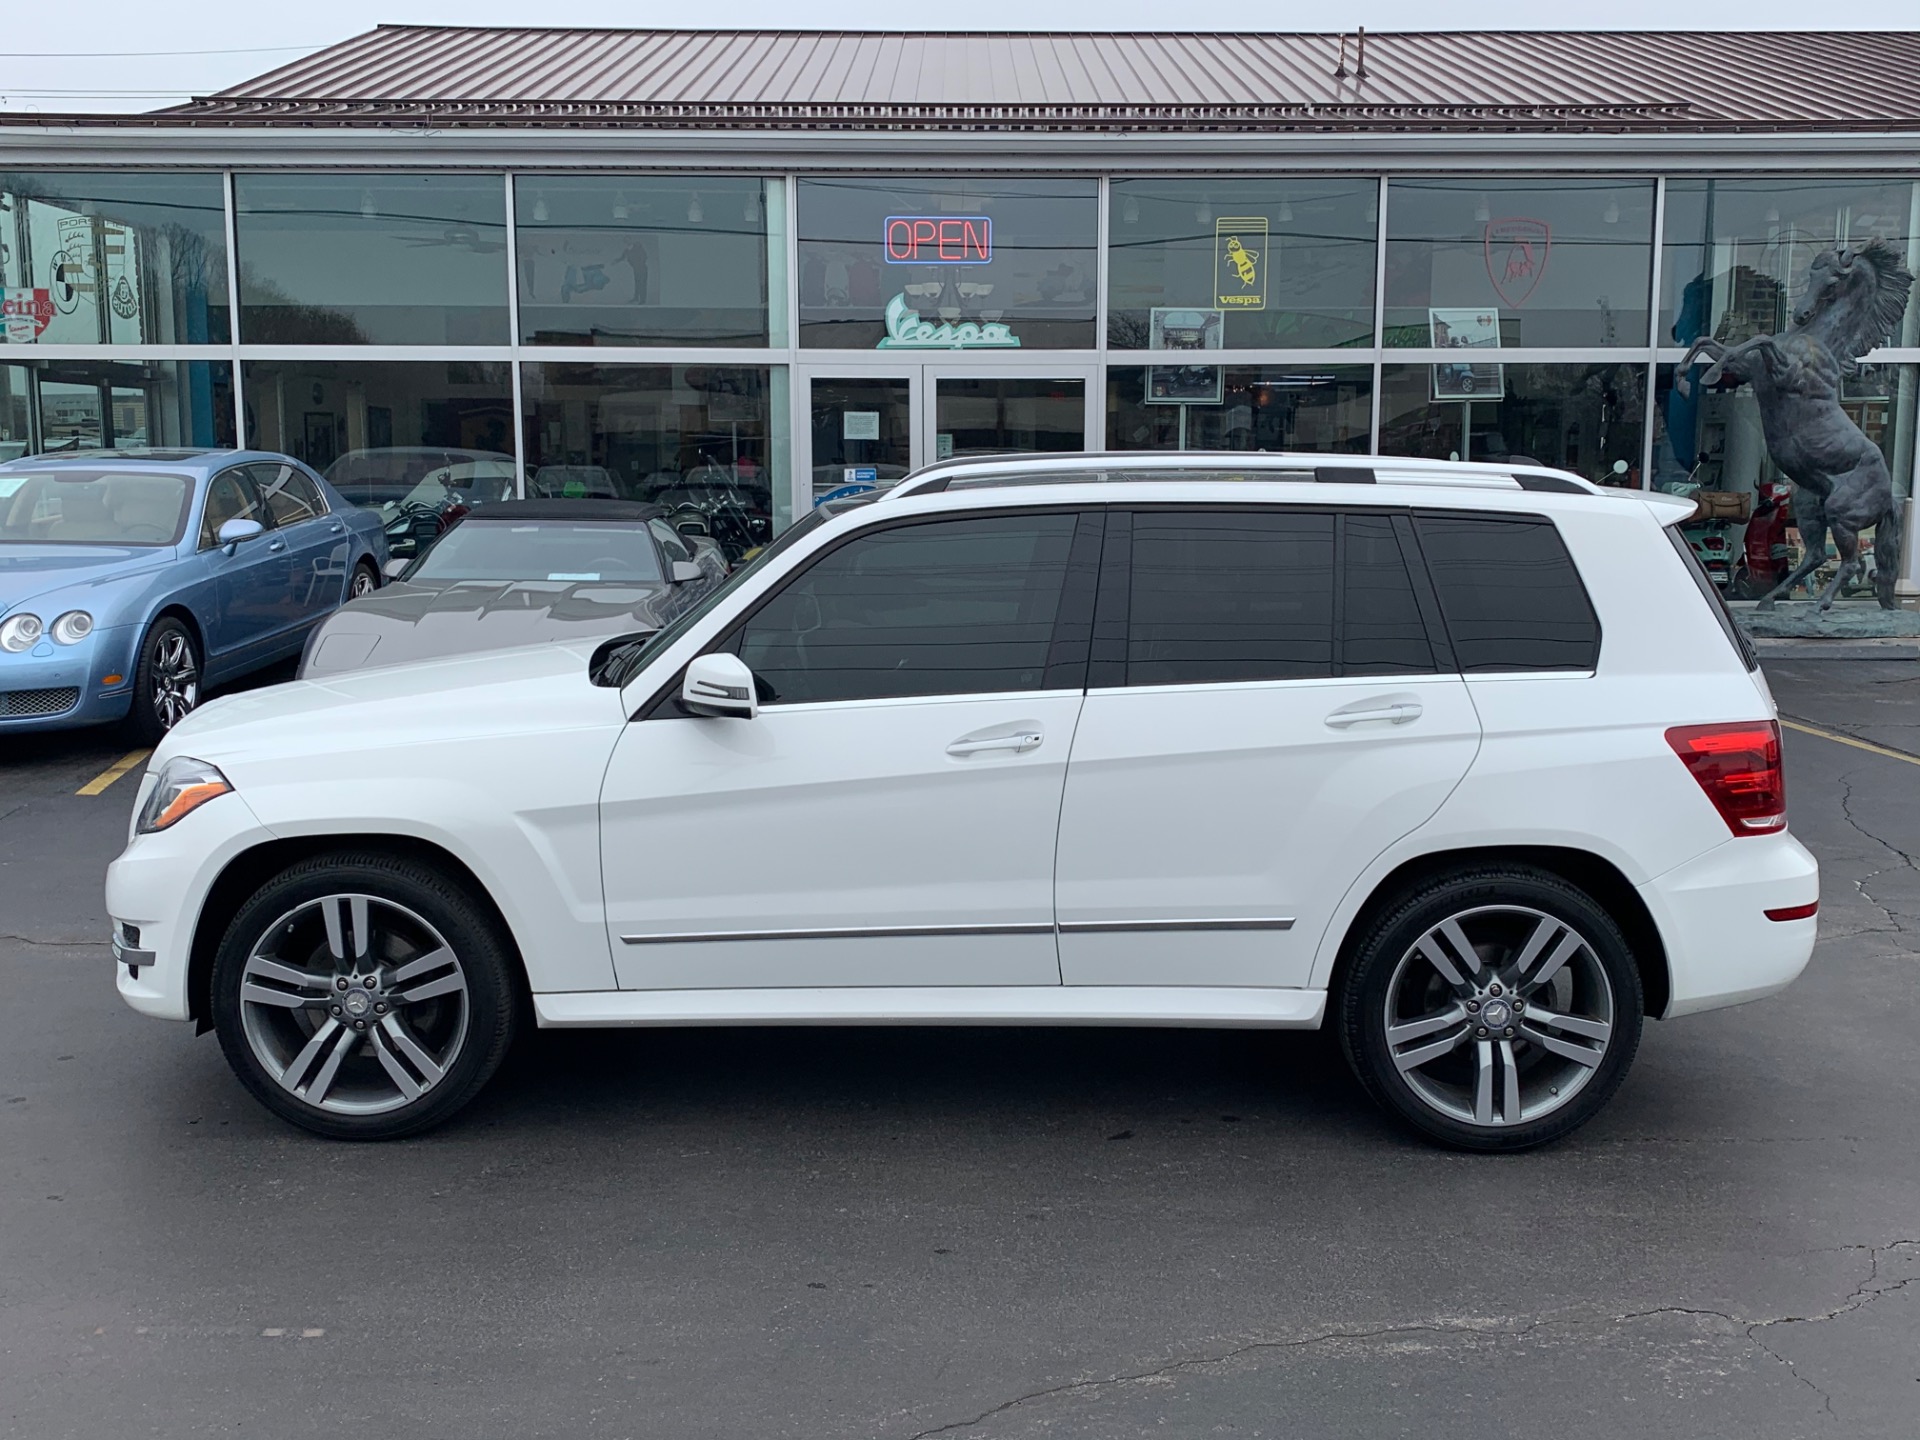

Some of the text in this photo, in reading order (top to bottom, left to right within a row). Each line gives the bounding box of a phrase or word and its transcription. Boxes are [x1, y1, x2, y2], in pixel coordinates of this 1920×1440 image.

[889, 220, 987, 259] OPEN
[1219, 295, 1261, 306] Vespa
[880, 292, 1021, 349] Vespa
